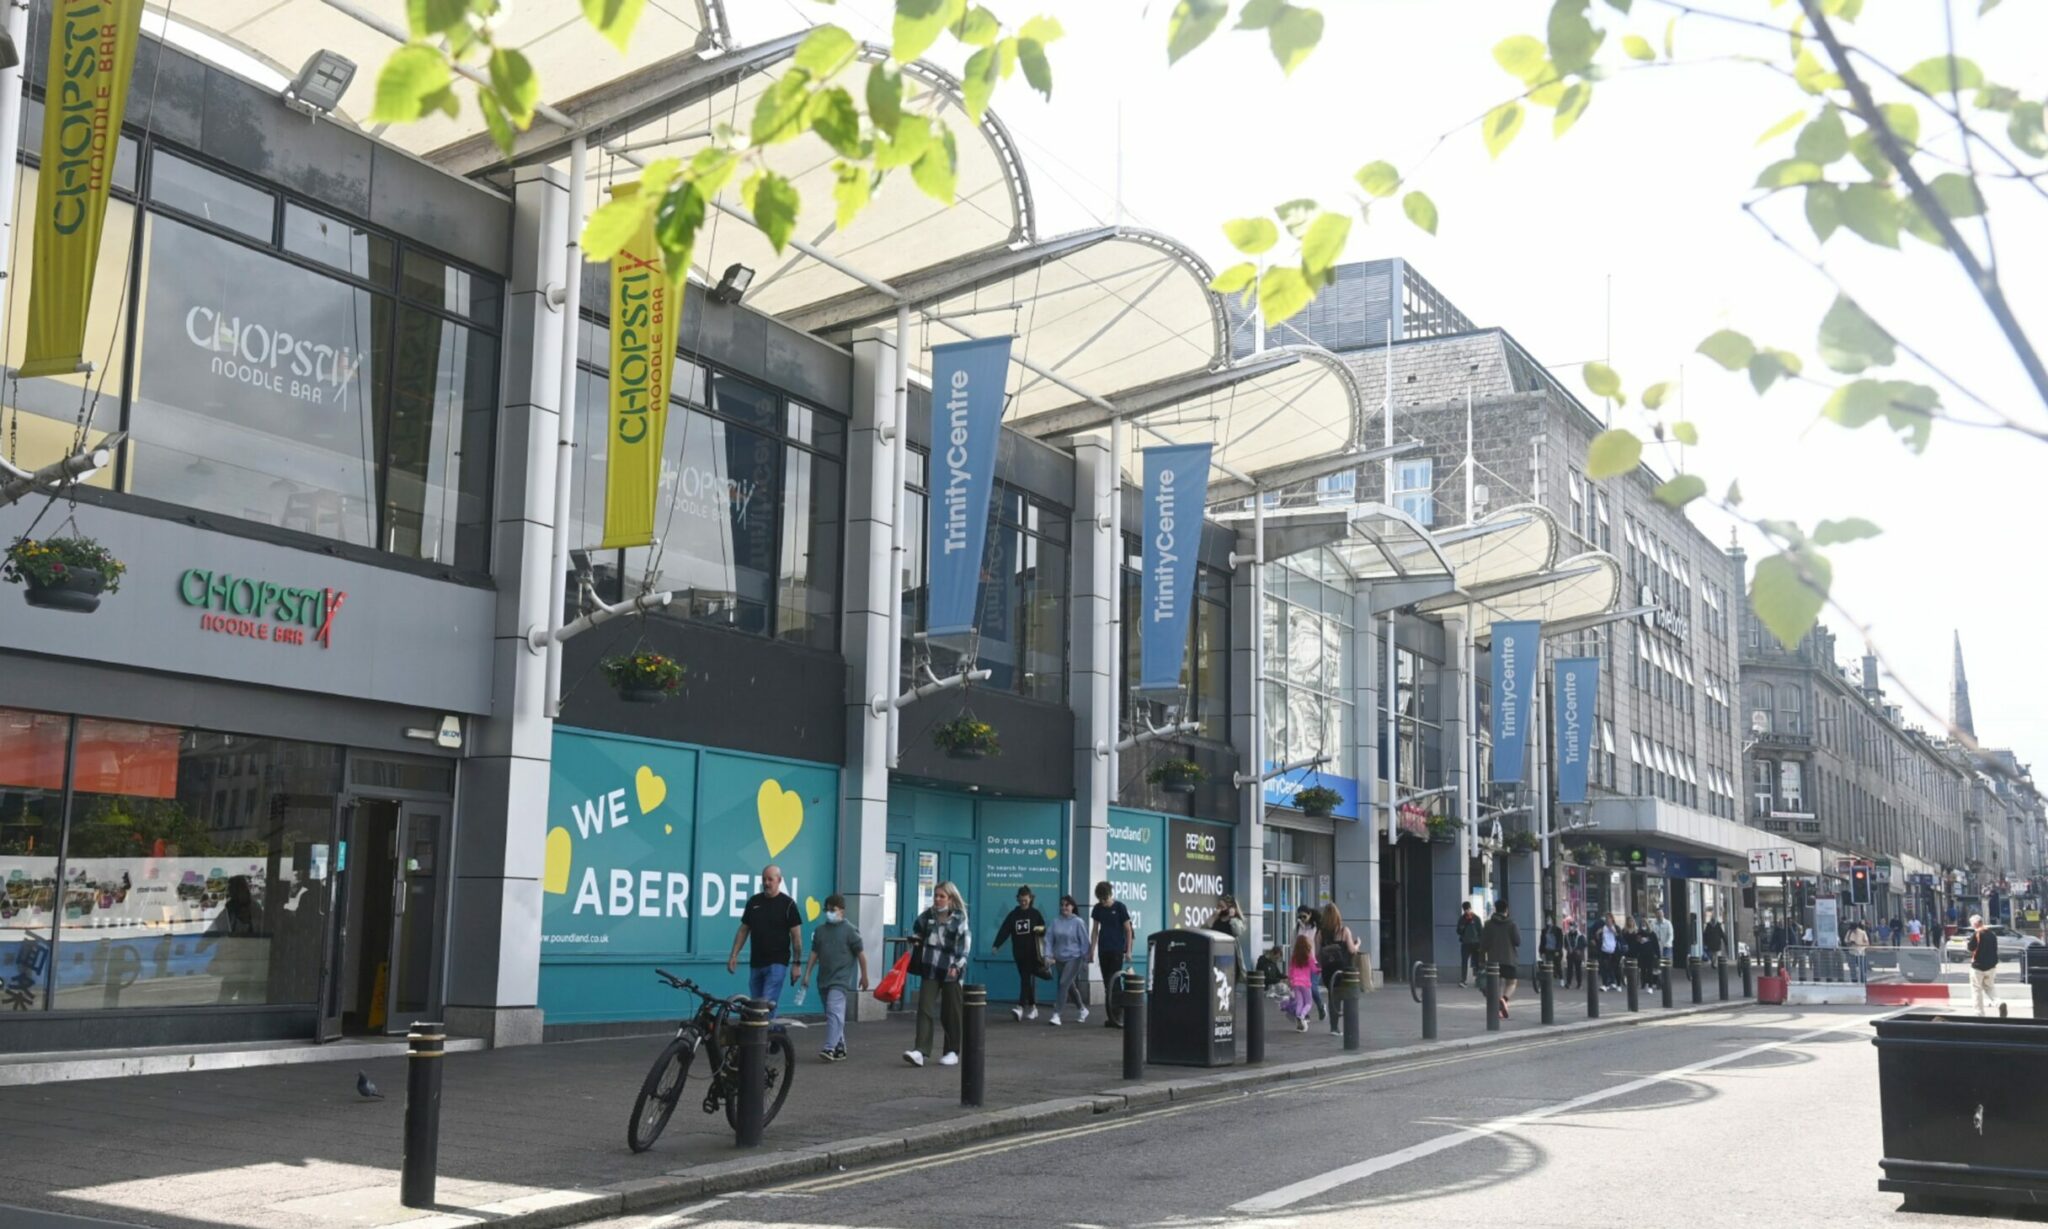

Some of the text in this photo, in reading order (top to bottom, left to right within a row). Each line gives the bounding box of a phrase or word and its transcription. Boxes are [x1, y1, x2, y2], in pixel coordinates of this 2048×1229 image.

[53, 0, 105, 235] CHOPSTI
[90, 24, 117, 190] NOODLE BAR
[650, 287, 664, 411] NOODLE BAR
[211, 356, 322, 404] NOODLE BAR
[944, 370, 971, 554] TrinityCentre
[1154, 469, 1178, 622] TrinityCentre
[201, 613, 305, 645] NOODLE BAR
[1502, 637, 1517, 739] TrinityCentre
[1565, 672, 1580, 765] TrinityCentre
[571, 788, 629, 839] WE
[987, 835, 1056, 846] Do you want to
[987, 847, 1043, 856] work for us?
[1106, 852, 1152, 874] OPENING
[1178, 872, 1223, 895] COMING
[1185, 906, 1217, 928] SOO
